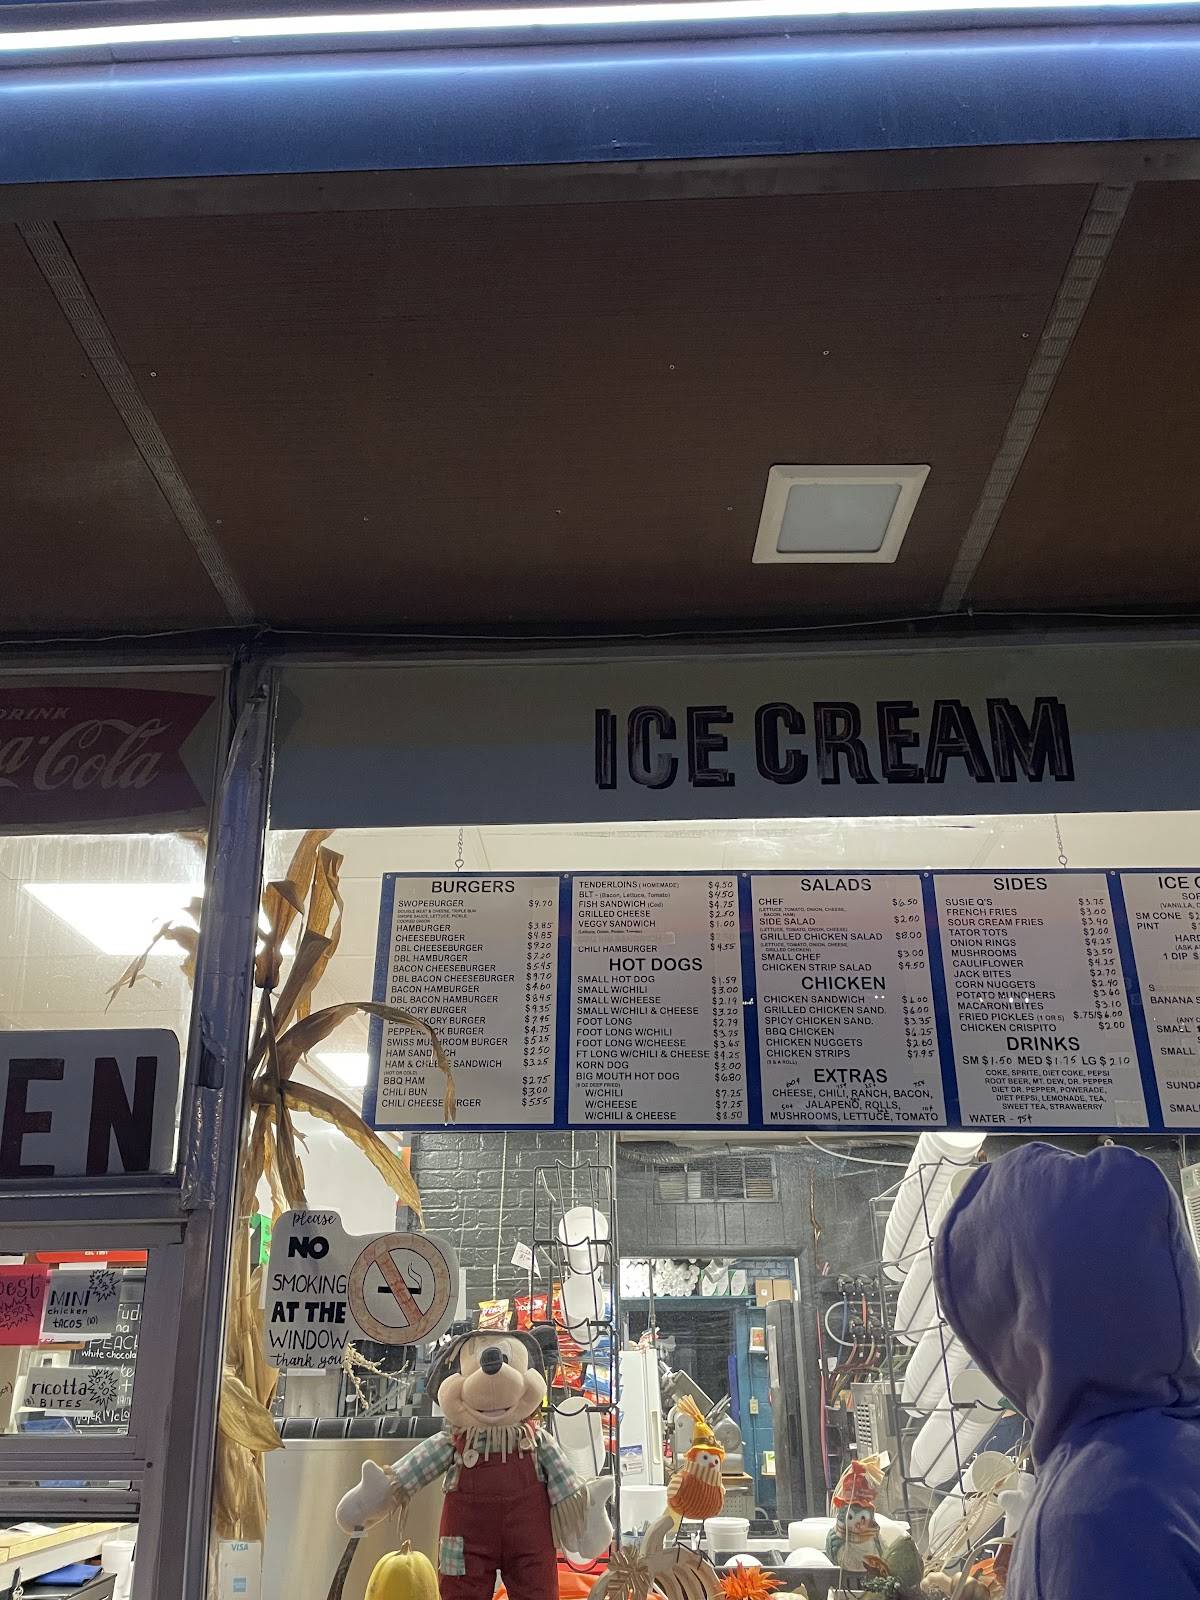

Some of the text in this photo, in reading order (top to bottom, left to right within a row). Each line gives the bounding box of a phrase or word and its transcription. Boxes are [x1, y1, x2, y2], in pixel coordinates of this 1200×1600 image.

[595, 697, 1075, 789] ICE CREAM
[432, 881, 515, 893] BURGERS
[801, 879, 871, 891] SALADS
[994, 878, 1047, 890] SIDES
[1159, 877, 1189, 888] ICE
[610, 958, 702, 970] HOT DOGS
[802, 977, 886, 989] CHICKEN
[1007, 1037, 1080, 1050] DRINKS
[962, 1056, 979, 1064] SM
[1018, 1056, 1042, 1064] MED
[1082, 1056, 1097, 1065] LG
[814, 1069, 887, 1082] EXTRAS
[772, 1089, 815, 1098] CHEESE,
[293, 1212, 336, 1226] please
[288, 1236, 329, 1259] NO
[272, 1274, 346, 1294] SMOKING
[50, 1290, 90, 1306] MINI
[271, 1302, 346, 1323] AT THE
[269, 1330, 349, 1349] WINDOW
[270, 1353, 344, 1368] thank you
[32, 1378, 88, 1395] ricotta
